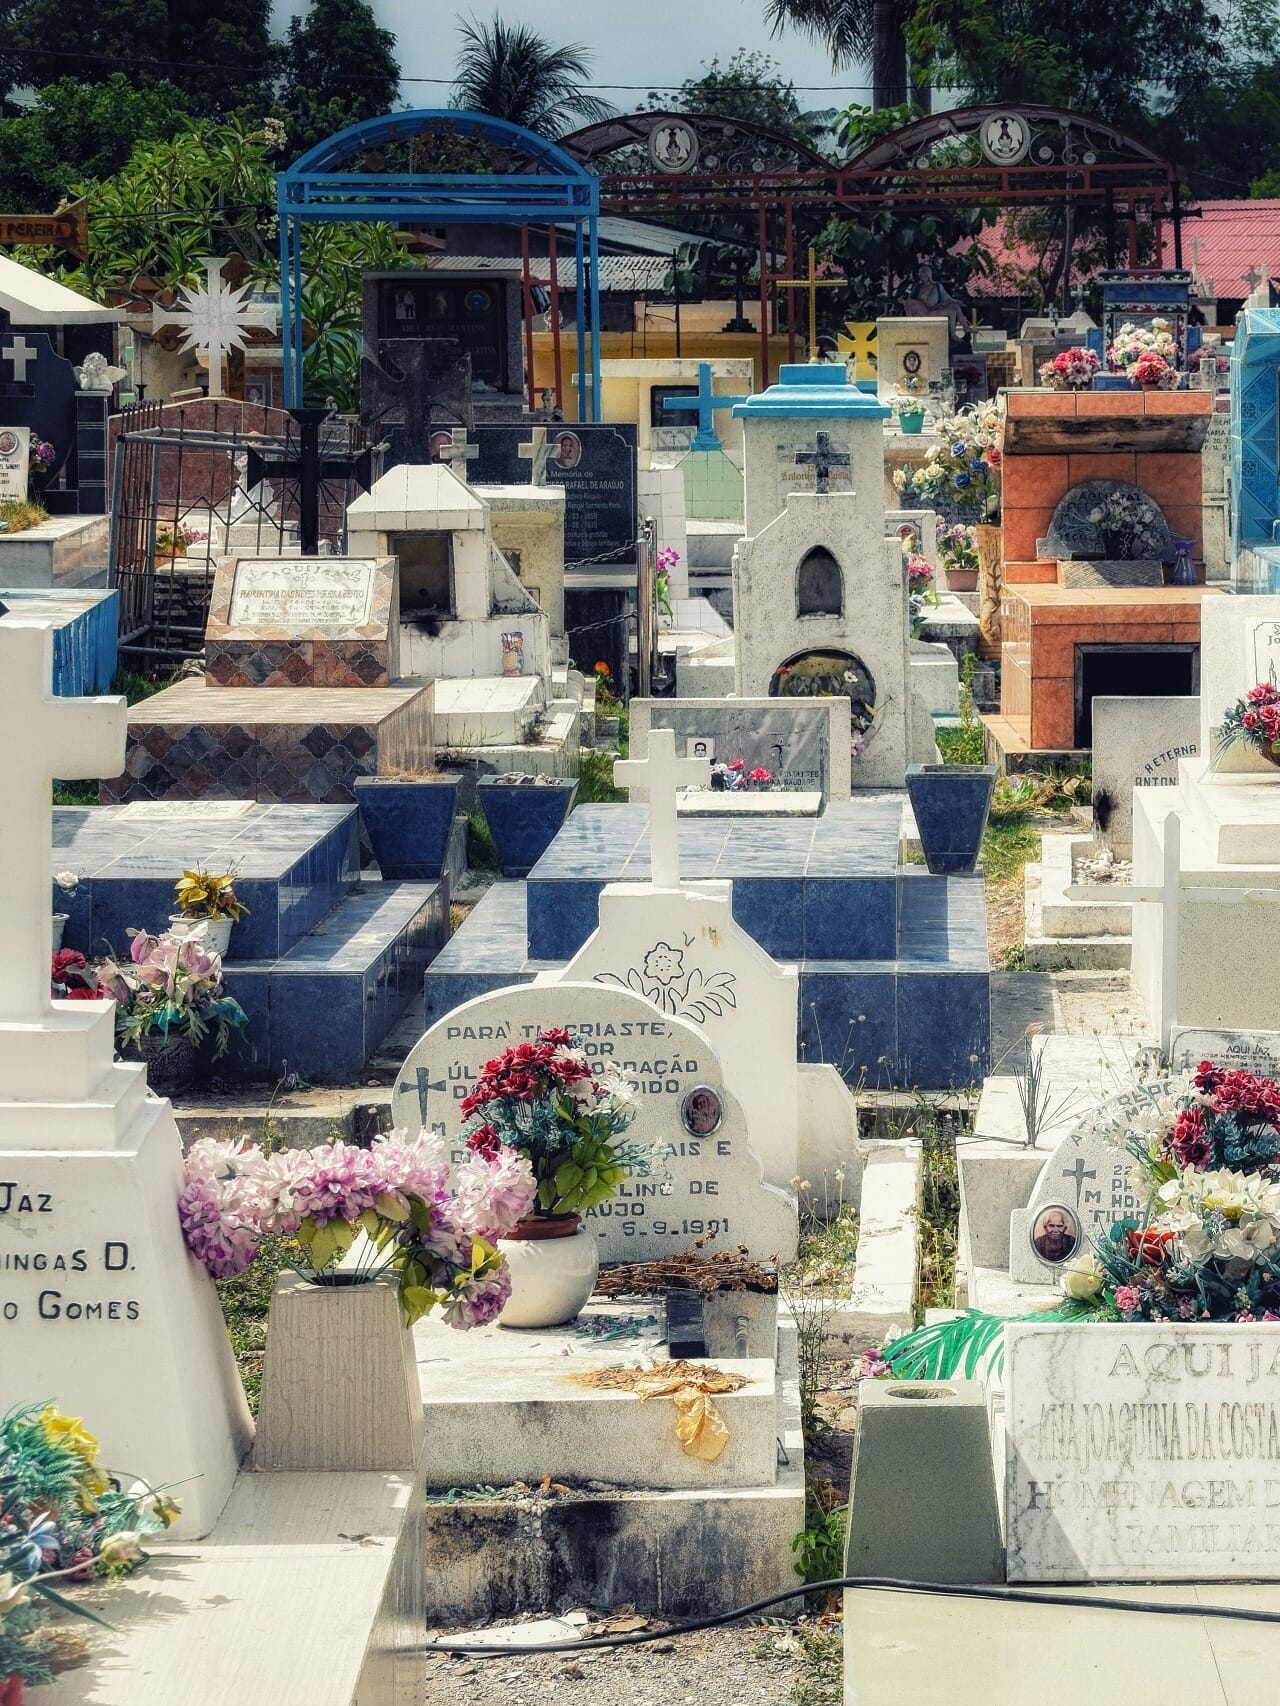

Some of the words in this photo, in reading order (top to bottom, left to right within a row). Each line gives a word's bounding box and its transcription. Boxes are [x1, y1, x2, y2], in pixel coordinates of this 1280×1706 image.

[6, 223, 64, 237] PEREIRA
[565, 481, 589, 490] RAFAEL
[590, 481, 598, 490] DE
[600, 480, 625, 490] ARAÚJO
[1135, 776, 1179, 787] ANTON
[1227, 1045, 1250, 1054] AQUI
[689, 1180, 719, 1196] DE
[1084, 1190, 1102, 1204] M
[104, 1241, 136, 1271] D.
[1108, 1342, 1235, 1385] AQUI
[1037, 1402, 1081, 1462] ANA
[1080, 1402, 1184, 1475] JOAQUINA
[1185, 1402, 1216, 1461] DA
[1218, 1402, 1280, 1461] COSTA
[1026, 1478, 1256, 1510] HOMENAGEM
